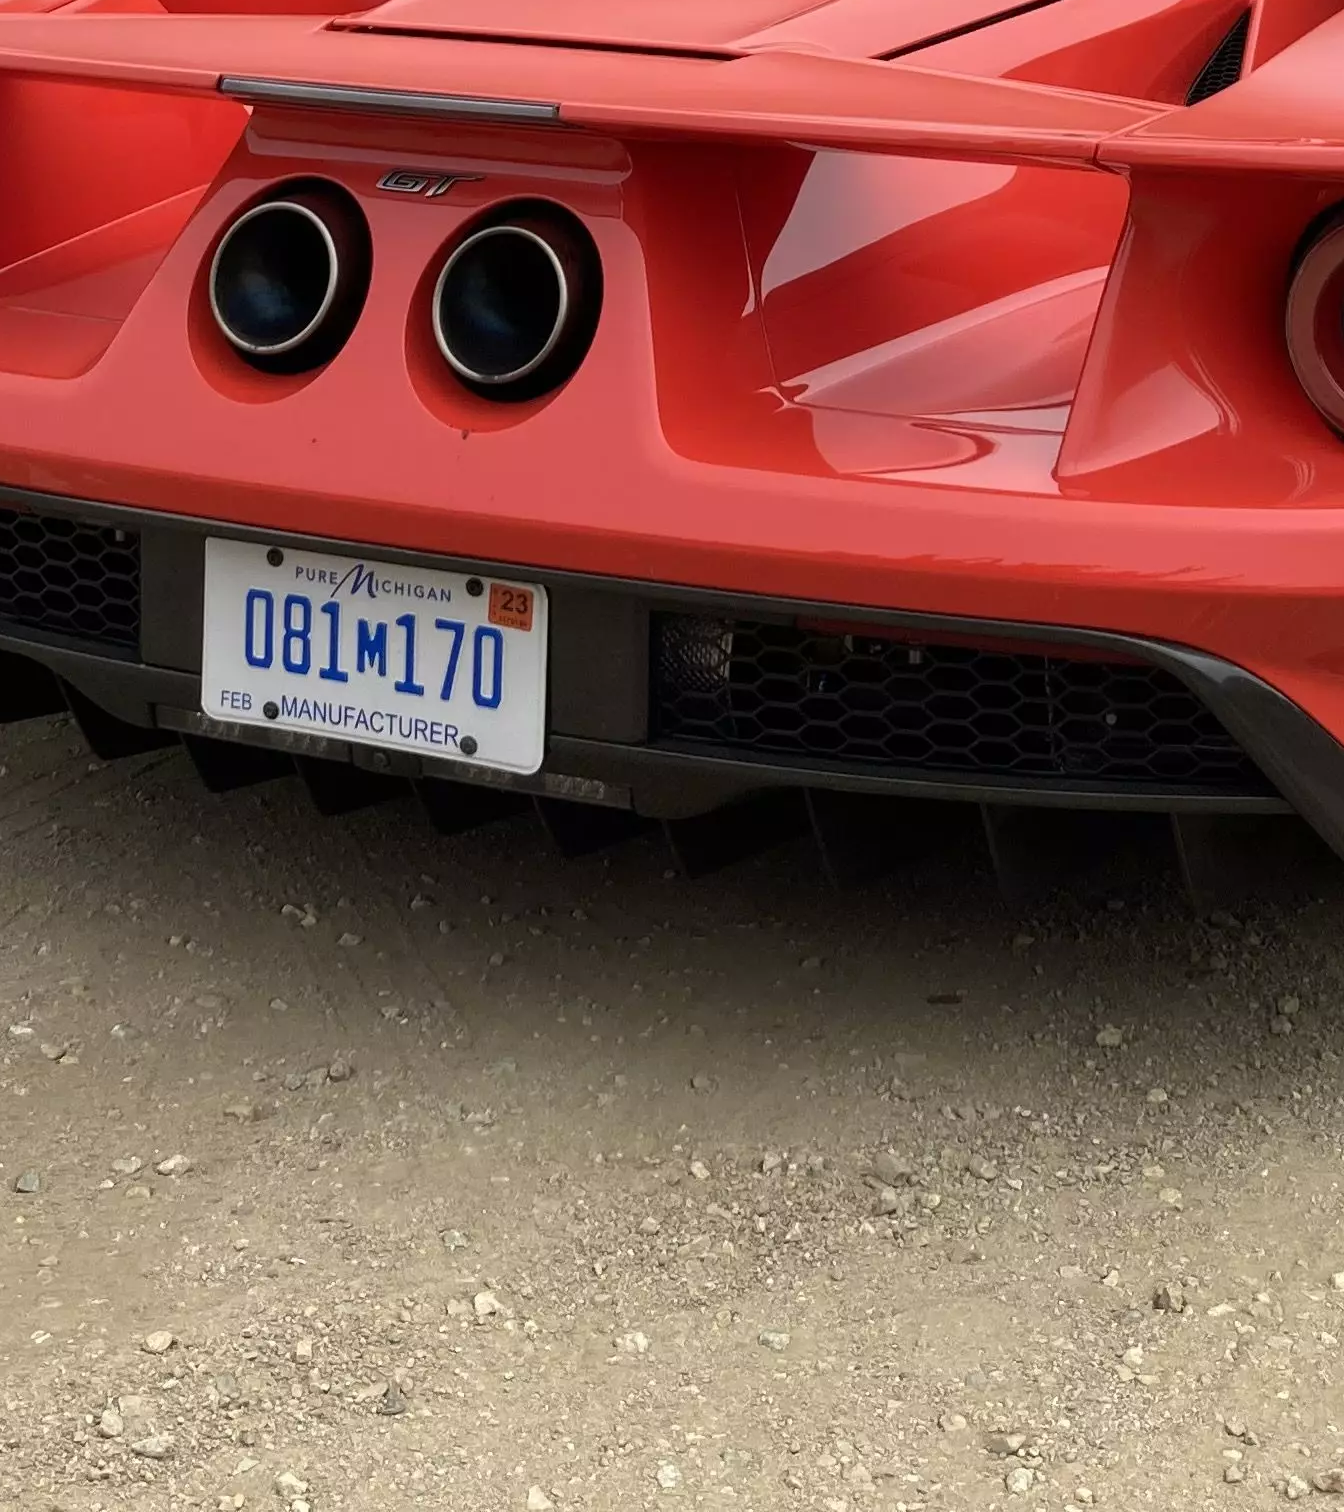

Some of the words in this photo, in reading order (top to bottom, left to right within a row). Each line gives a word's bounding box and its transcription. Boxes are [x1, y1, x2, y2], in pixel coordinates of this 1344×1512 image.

[376, 168, 485, 198] GT
[296, 566, 338, 585] PURE
[331, 564, 452, 603] MICHIGAN
[500, 590, 528, 614] 23
[245, 588, 504, 709] 081M170
[220, 689, 253, 711] FEB
[280, 694, 460, 749] MANUFACTURER
